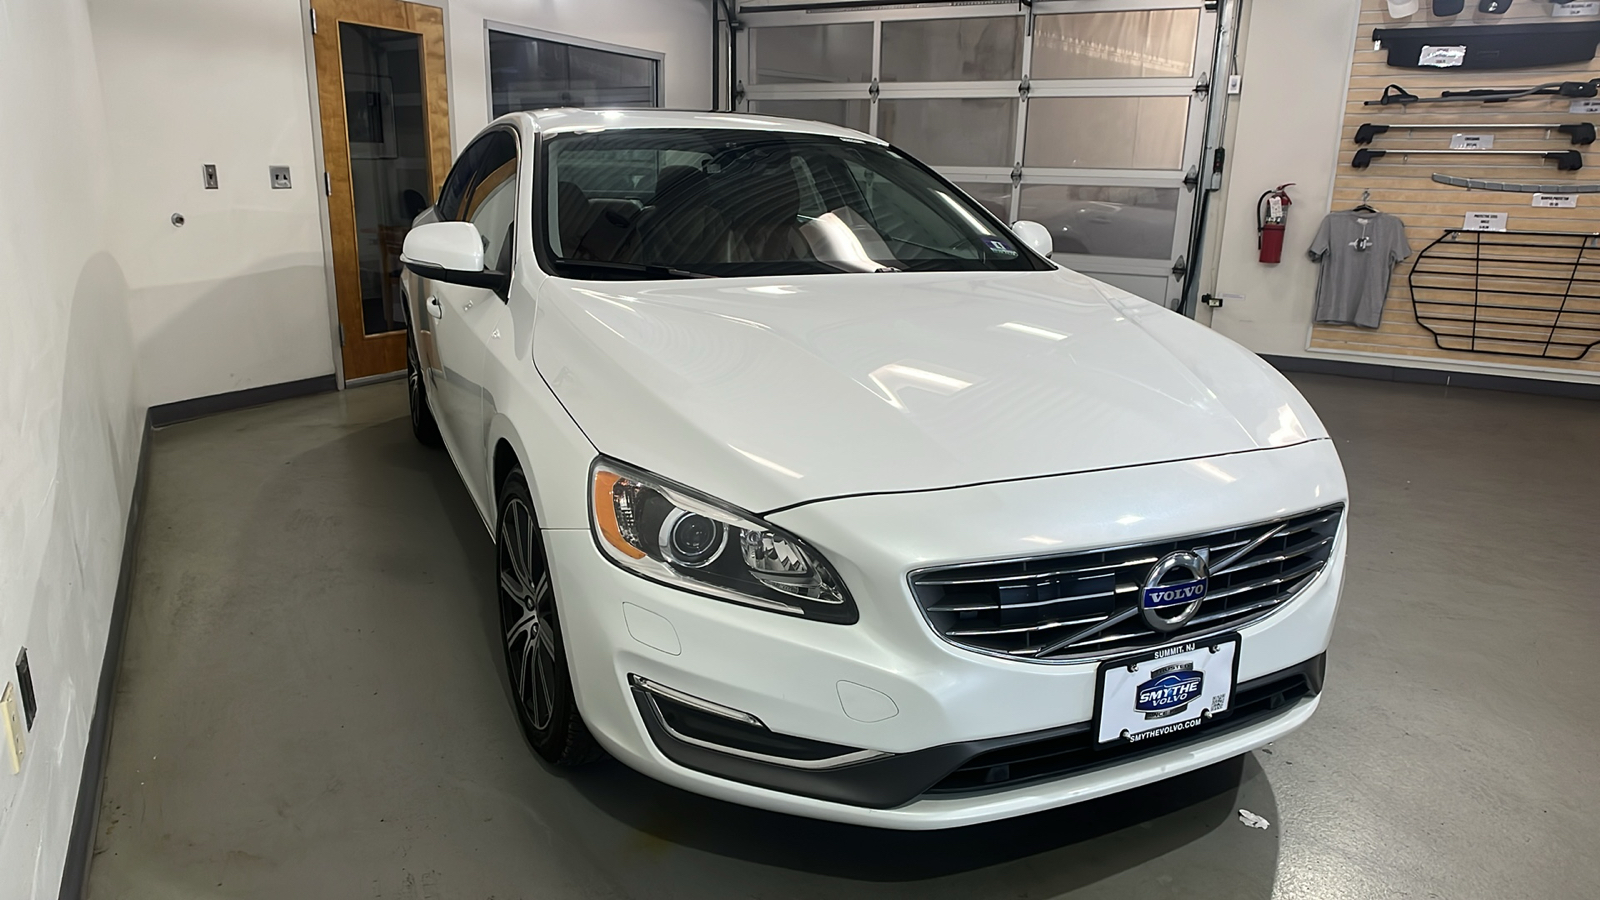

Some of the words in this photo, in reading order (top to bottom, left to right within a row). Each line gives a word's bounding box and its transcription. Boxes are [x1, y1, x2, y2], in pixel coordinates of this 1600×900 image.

[1148, 584, 1204, 603] VOLVO
[1185, 643, 1196, 652] NJ
[1139, 681, 1200, 704] SMYTHE
[1152, 693, 1188, 707] VOLVO
[1129, 718, 1202, 743] SMYTHEVOLVO.COM
